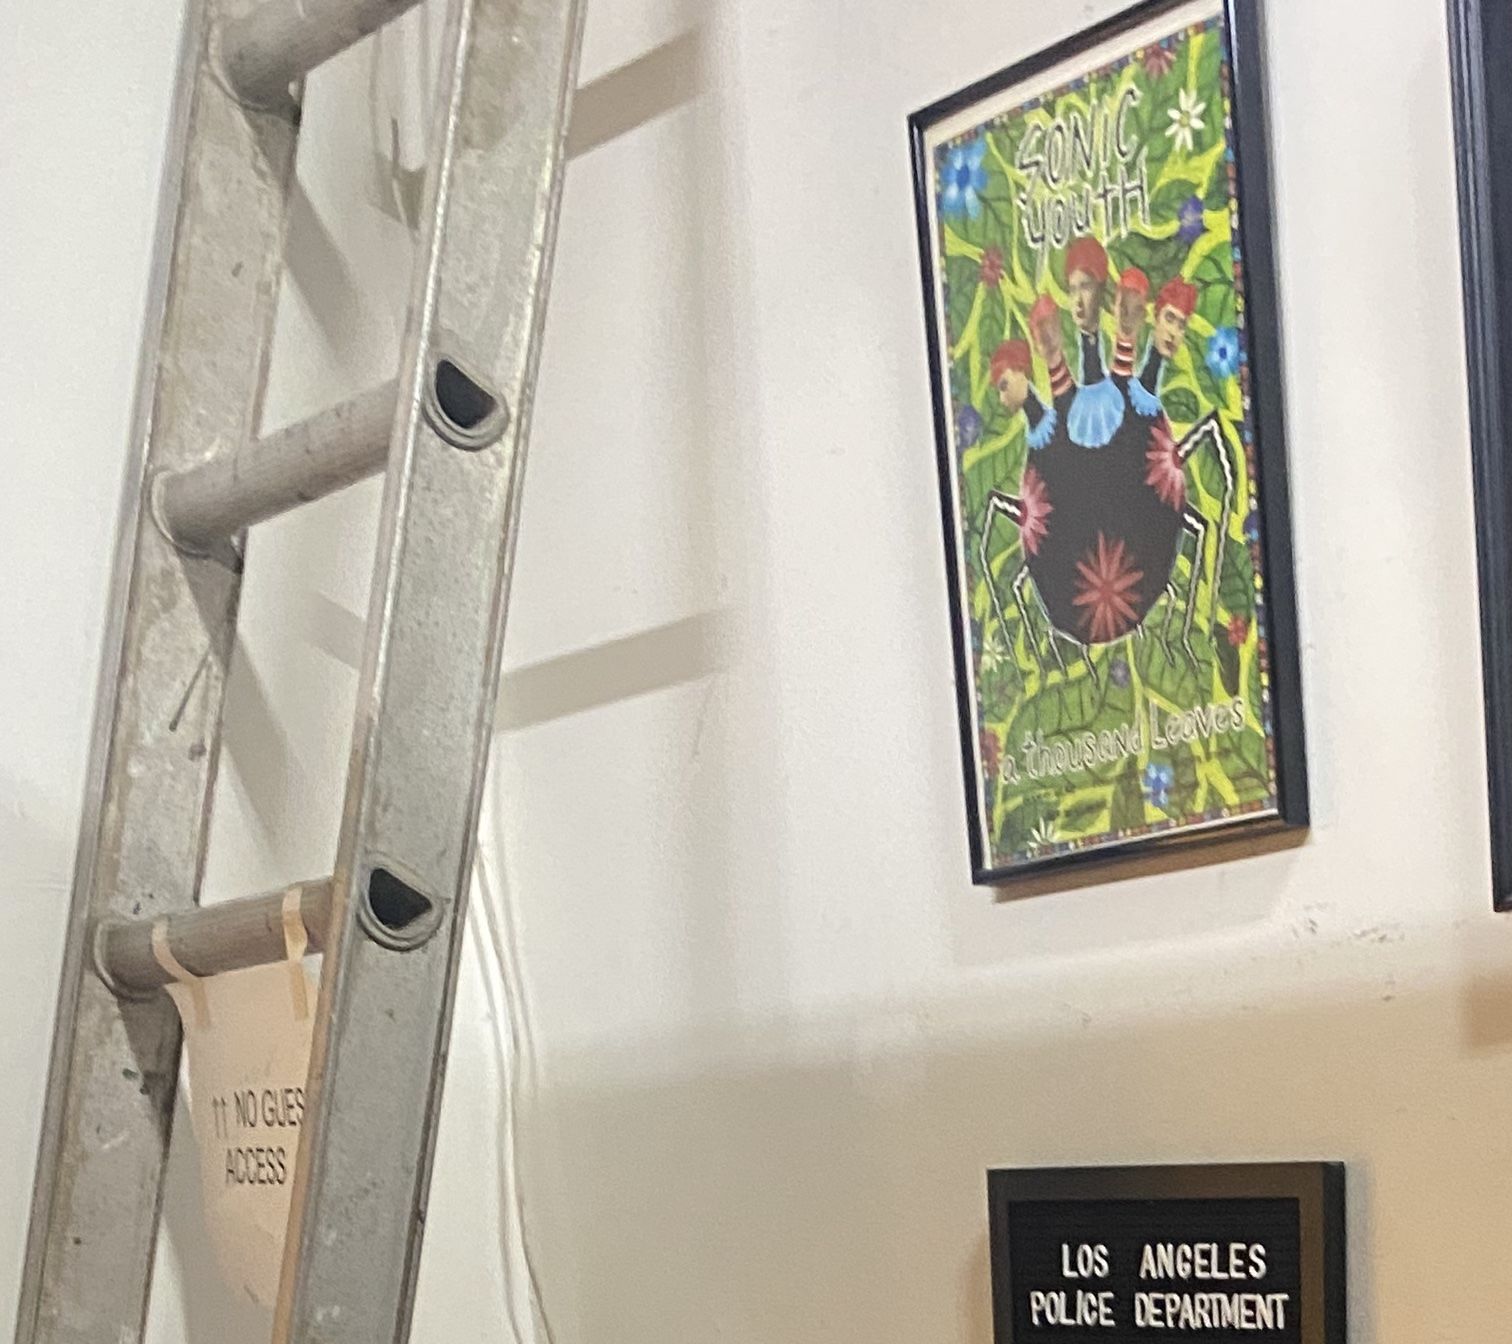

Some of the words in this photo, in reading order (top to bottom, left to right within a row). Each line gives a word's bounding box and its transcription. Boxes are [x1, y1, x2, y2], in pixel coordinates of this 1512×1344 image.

[234, 1089, 258, 1128] NO
[261, 1087, 304, 1128] GUES
[226, 1146, 287, 1185] ACCESS
[1061, 1243, 1109, 1280] LOS
[1139, 1243, 1267, 1280] ANGELES
[1030, 1291, 1116, 1328] POLICE
[1134, 1293, 1289, 1331] DEPARTMENT
